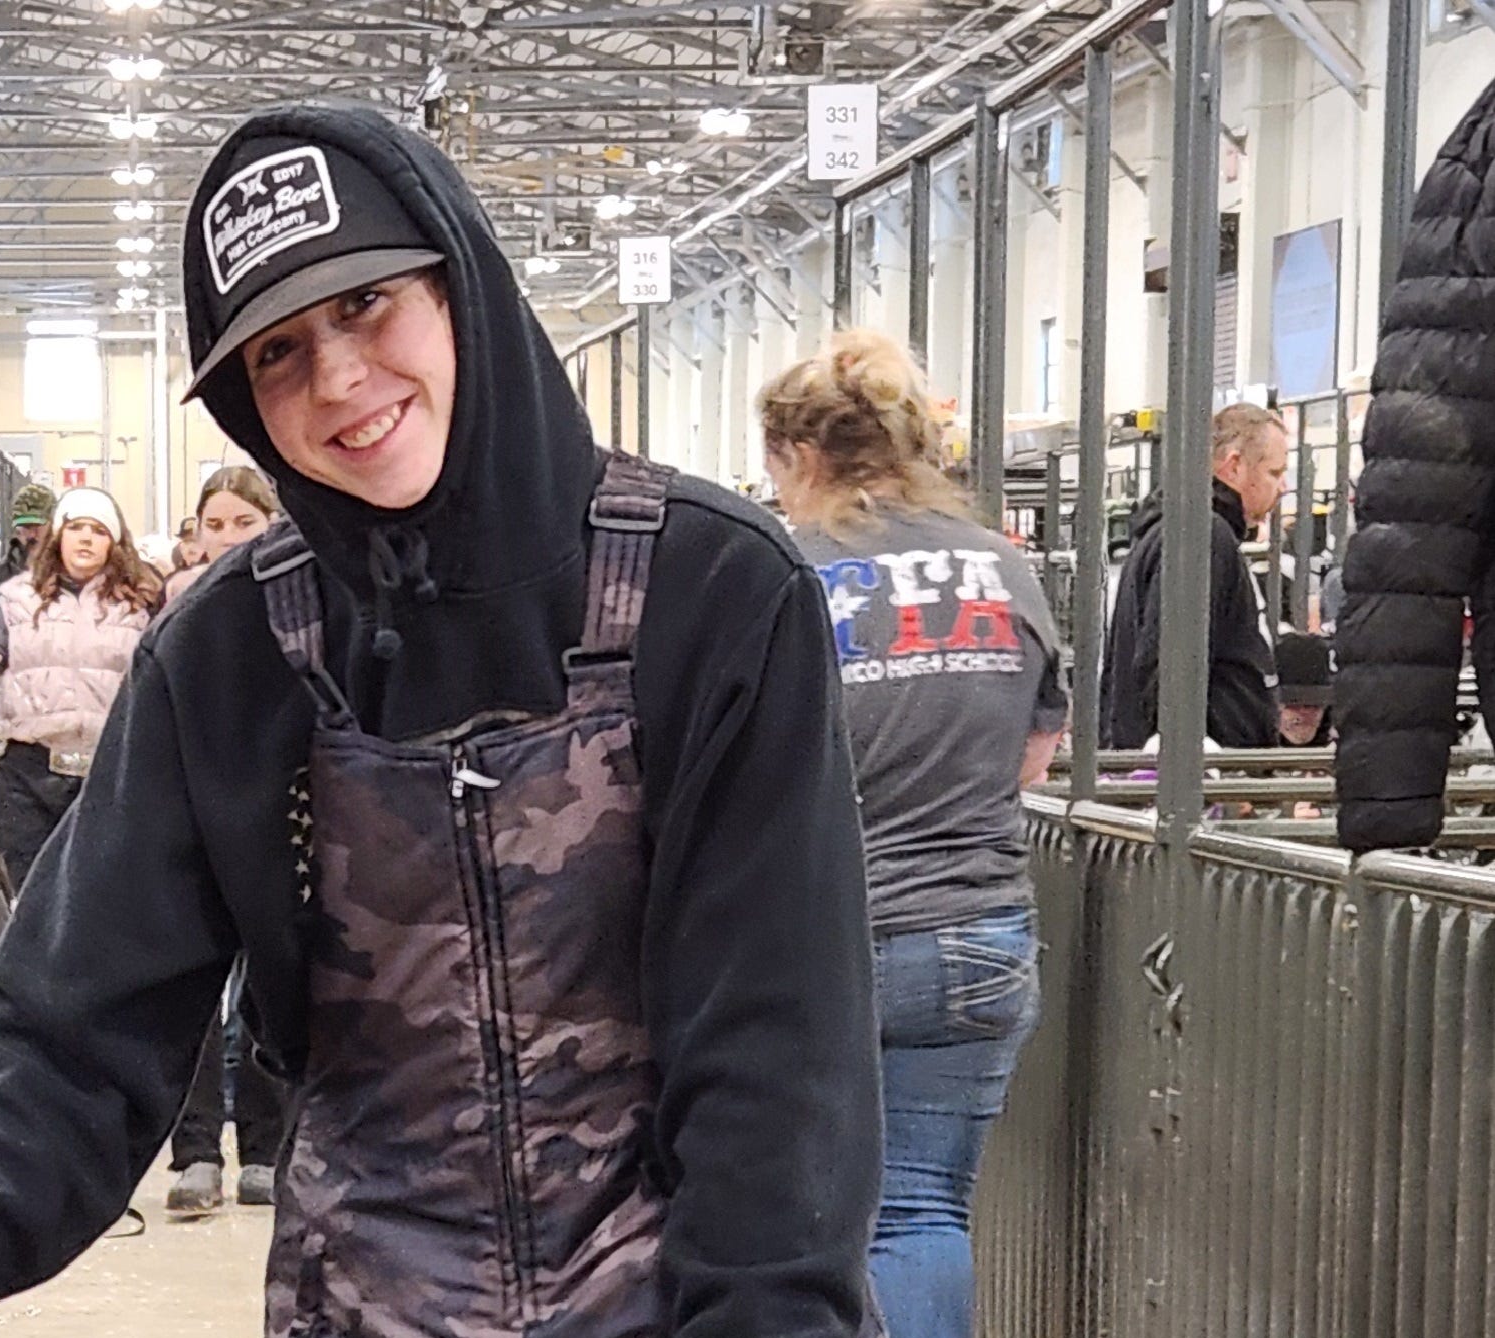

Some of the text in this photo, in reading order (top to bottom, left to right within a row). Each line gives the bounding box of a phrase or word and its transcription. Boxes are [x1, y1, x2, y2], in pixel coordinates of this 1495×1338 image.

[825, 106, 858, 123] 331
[825, 151, 859, 169] 342
[246, 209, 306, 247] Company
[633, 252, 658, 265] 316
[633, 284, 658, 297] 330
[886, 655, 943, 679] HIGH
[944, 651, 1024, 672] SCHOOL
